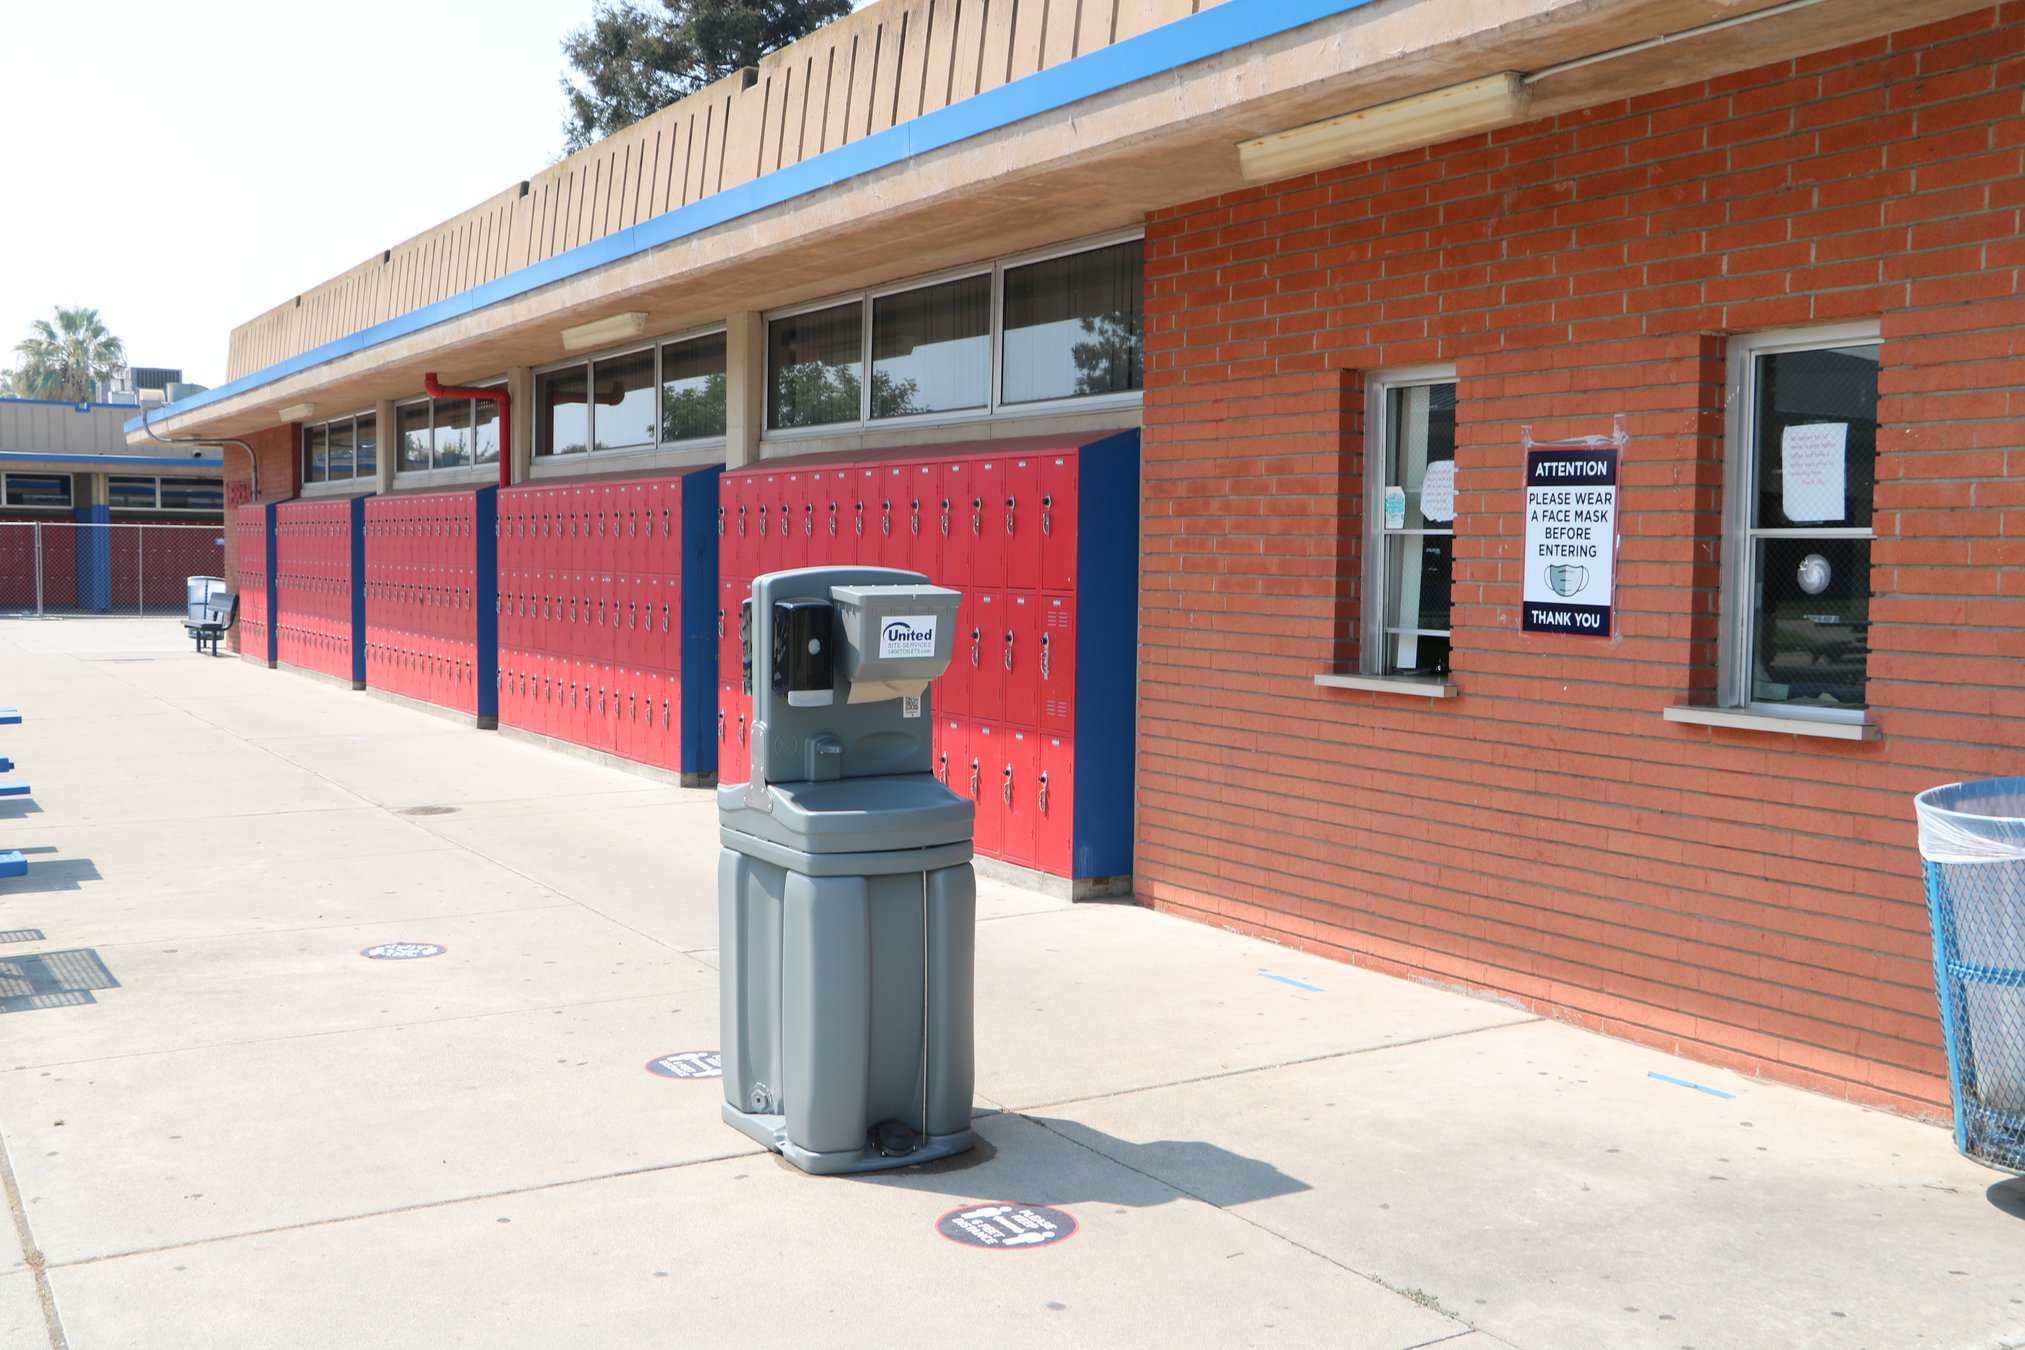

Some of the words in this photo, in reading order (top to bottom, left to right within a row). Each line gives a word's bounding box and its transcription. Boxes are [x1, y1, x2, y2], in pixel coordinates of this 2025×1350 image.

[1535, 461, 1608, 477] ATTENTION
[1529, 492, 1571, 505] PLEASE
[1575, 492, 1612, 505] WEAR
[1531, 510, 1539, 522] A
[1542, 510, 1571, 523] FACE
[1574, 510, 1608, 523] MASK
[1545, 527, 1591, 540] BEFORE
[1538, 544, 1597, 558] ENTERING
[1531, 610, 1572, 626] THANK
[1575, 612, 1600, 628] YOU
[888, 629, 932, 641] United
